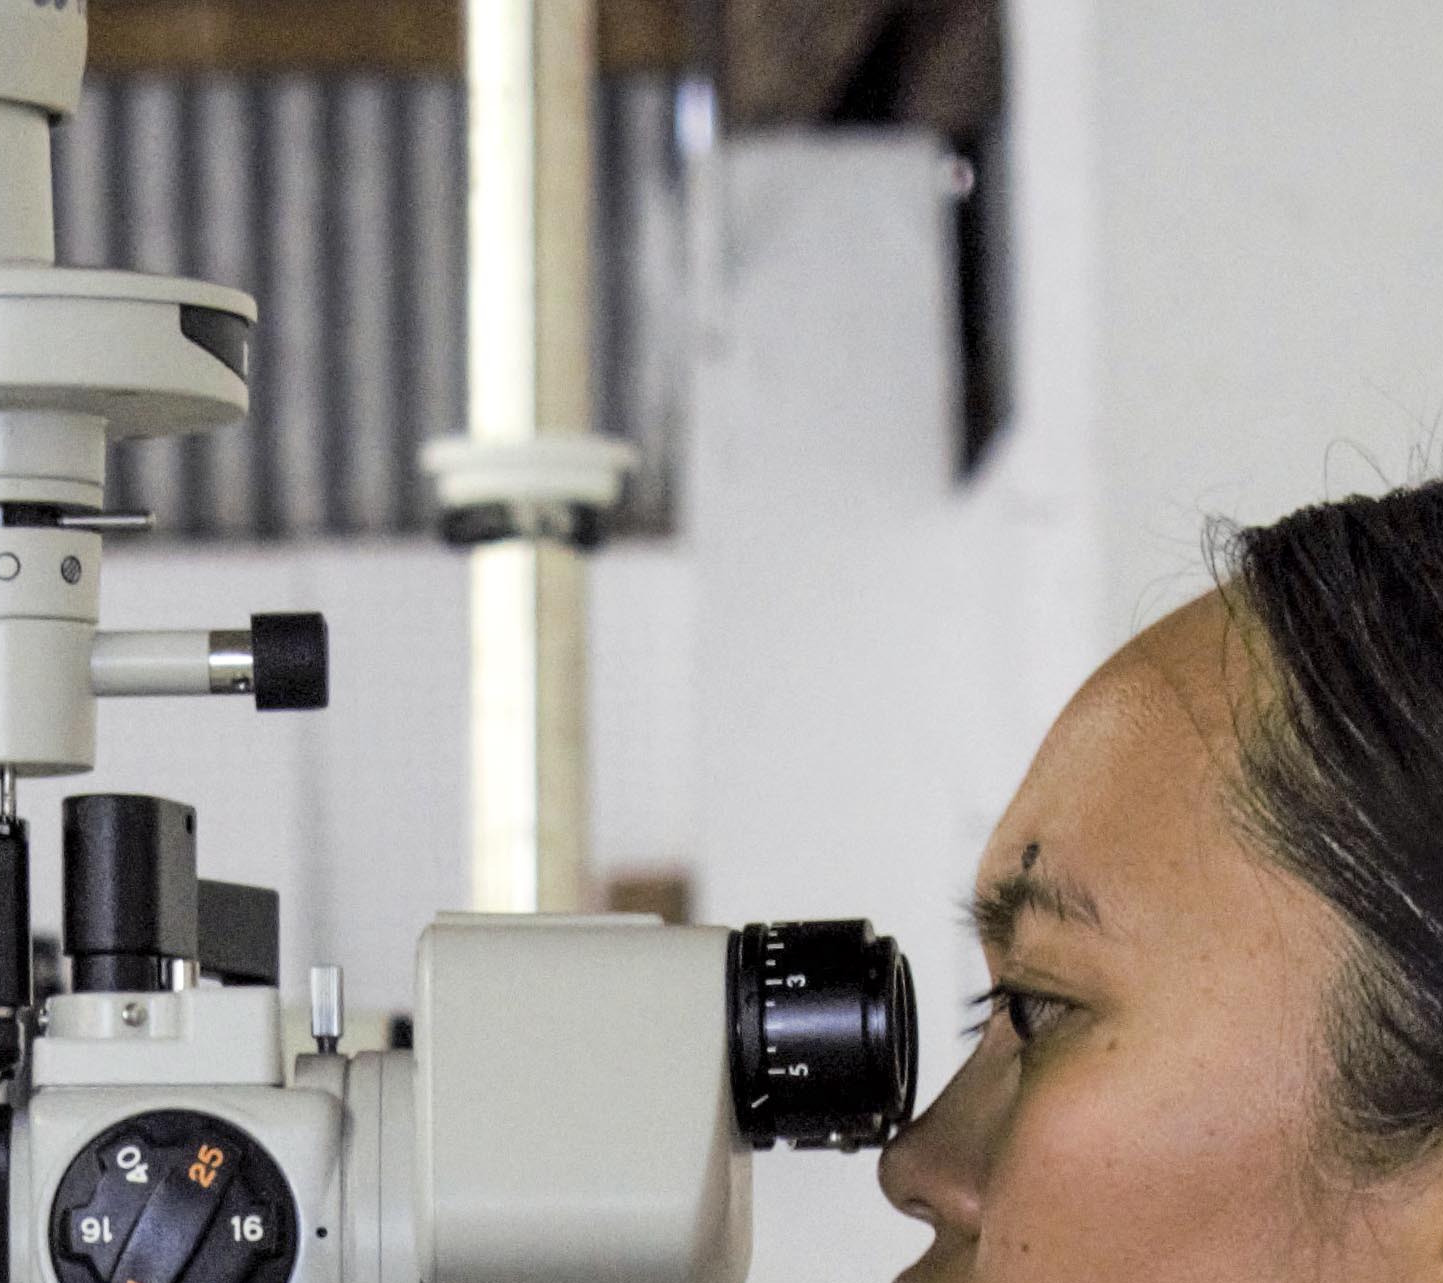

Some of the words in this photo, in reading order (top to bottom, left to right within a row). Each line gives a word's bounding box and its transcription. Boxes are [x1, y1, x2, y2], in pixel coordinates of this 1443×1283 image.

[786, 973, 807, 988] 3
[789, 1062, 809, 1077] 5
[116, 1145, 149, 1184] 40
[188, 1144, 224, 1188] 25
[80, 1216, 113, 1244] 16
[230, 1215, 264, 1242] 16
